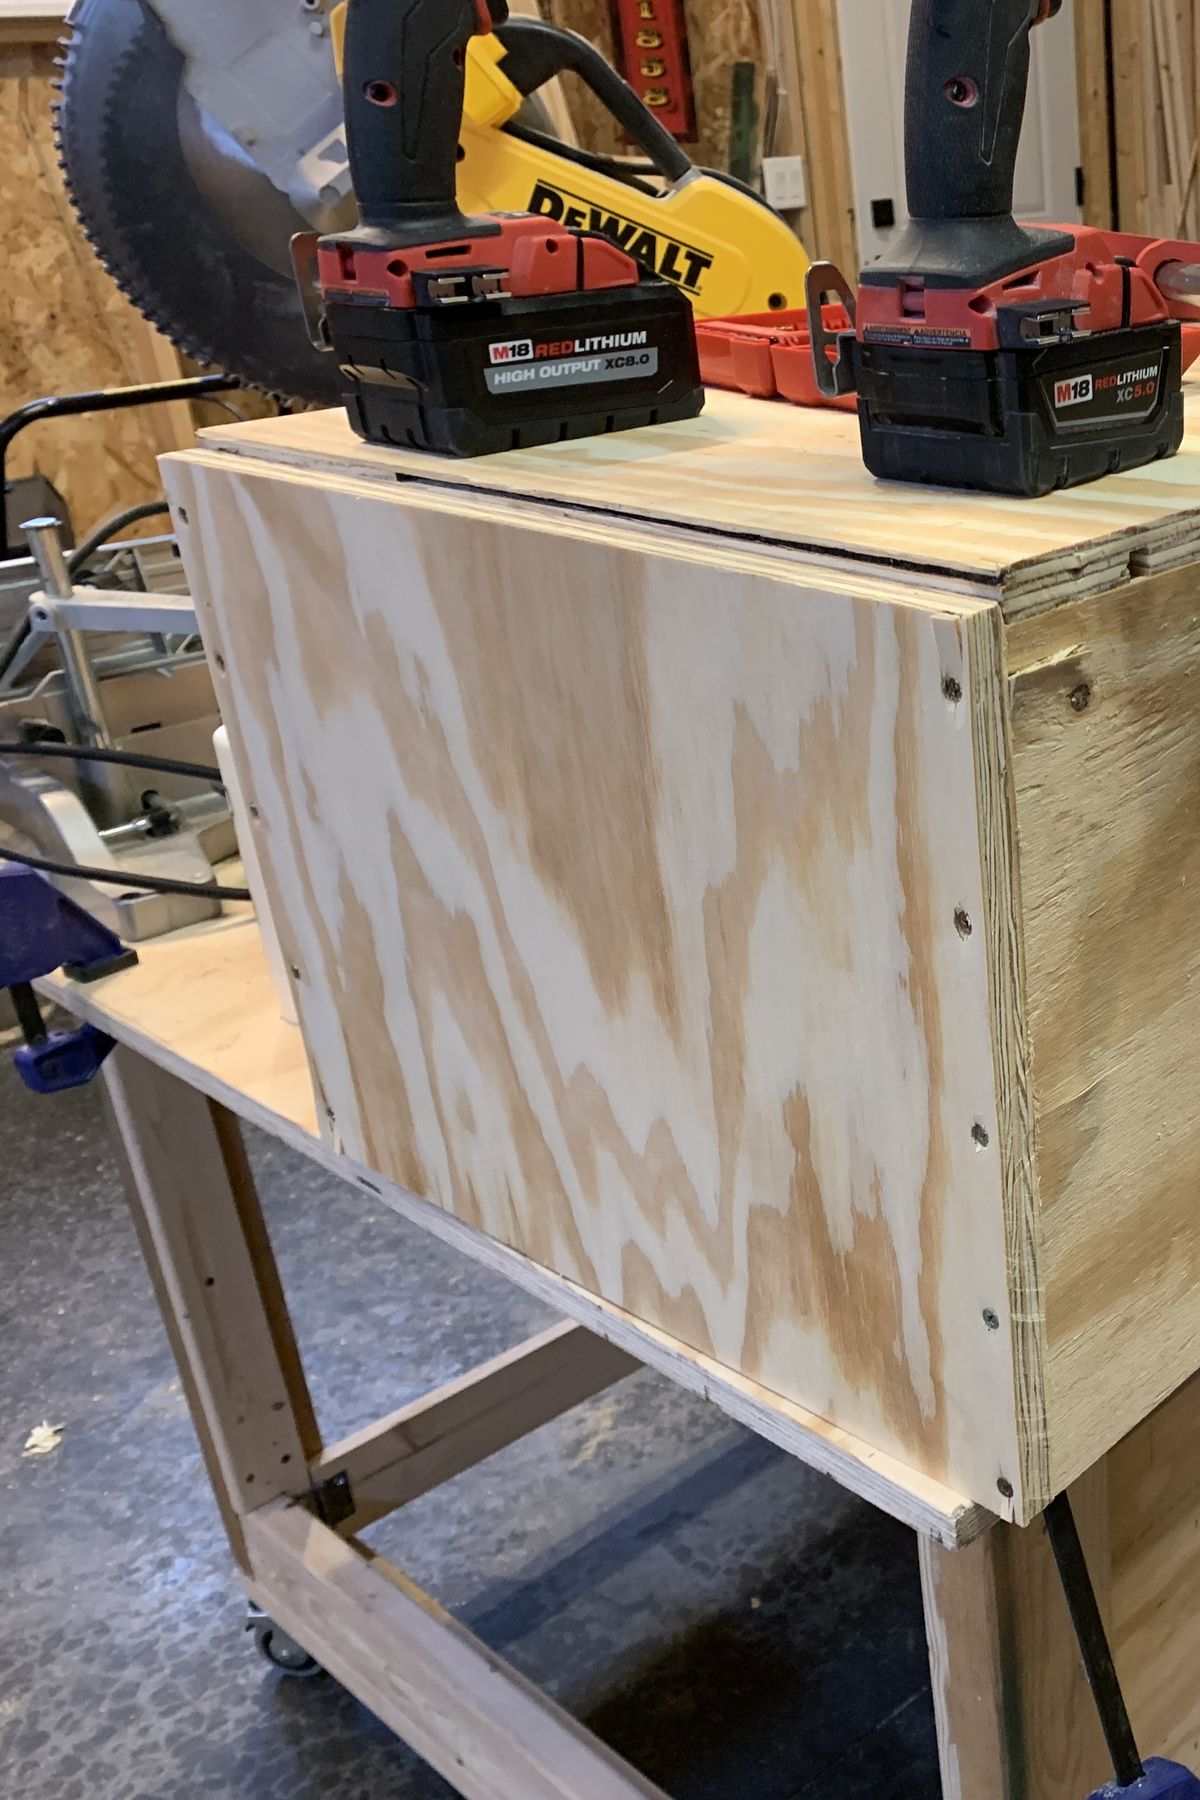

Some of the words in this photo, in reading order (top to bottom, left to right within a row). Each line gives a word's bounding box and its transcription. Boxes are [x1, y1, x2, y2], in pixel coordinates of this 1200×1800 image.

[493, 342, 530, 361] M18
[534, 330, 648, 358] REDLITHIUM
[494, 368, 535, 385] HIGH
[539, 358, 601, 378] OUTPUT
[604, 353, 650, 370] XC8.0
[1056, 379, 1091, 404] M18
[1094, 364, 1159, 391] REDLITHIUM
[1115, 379, 1156, 404] XC5.0
